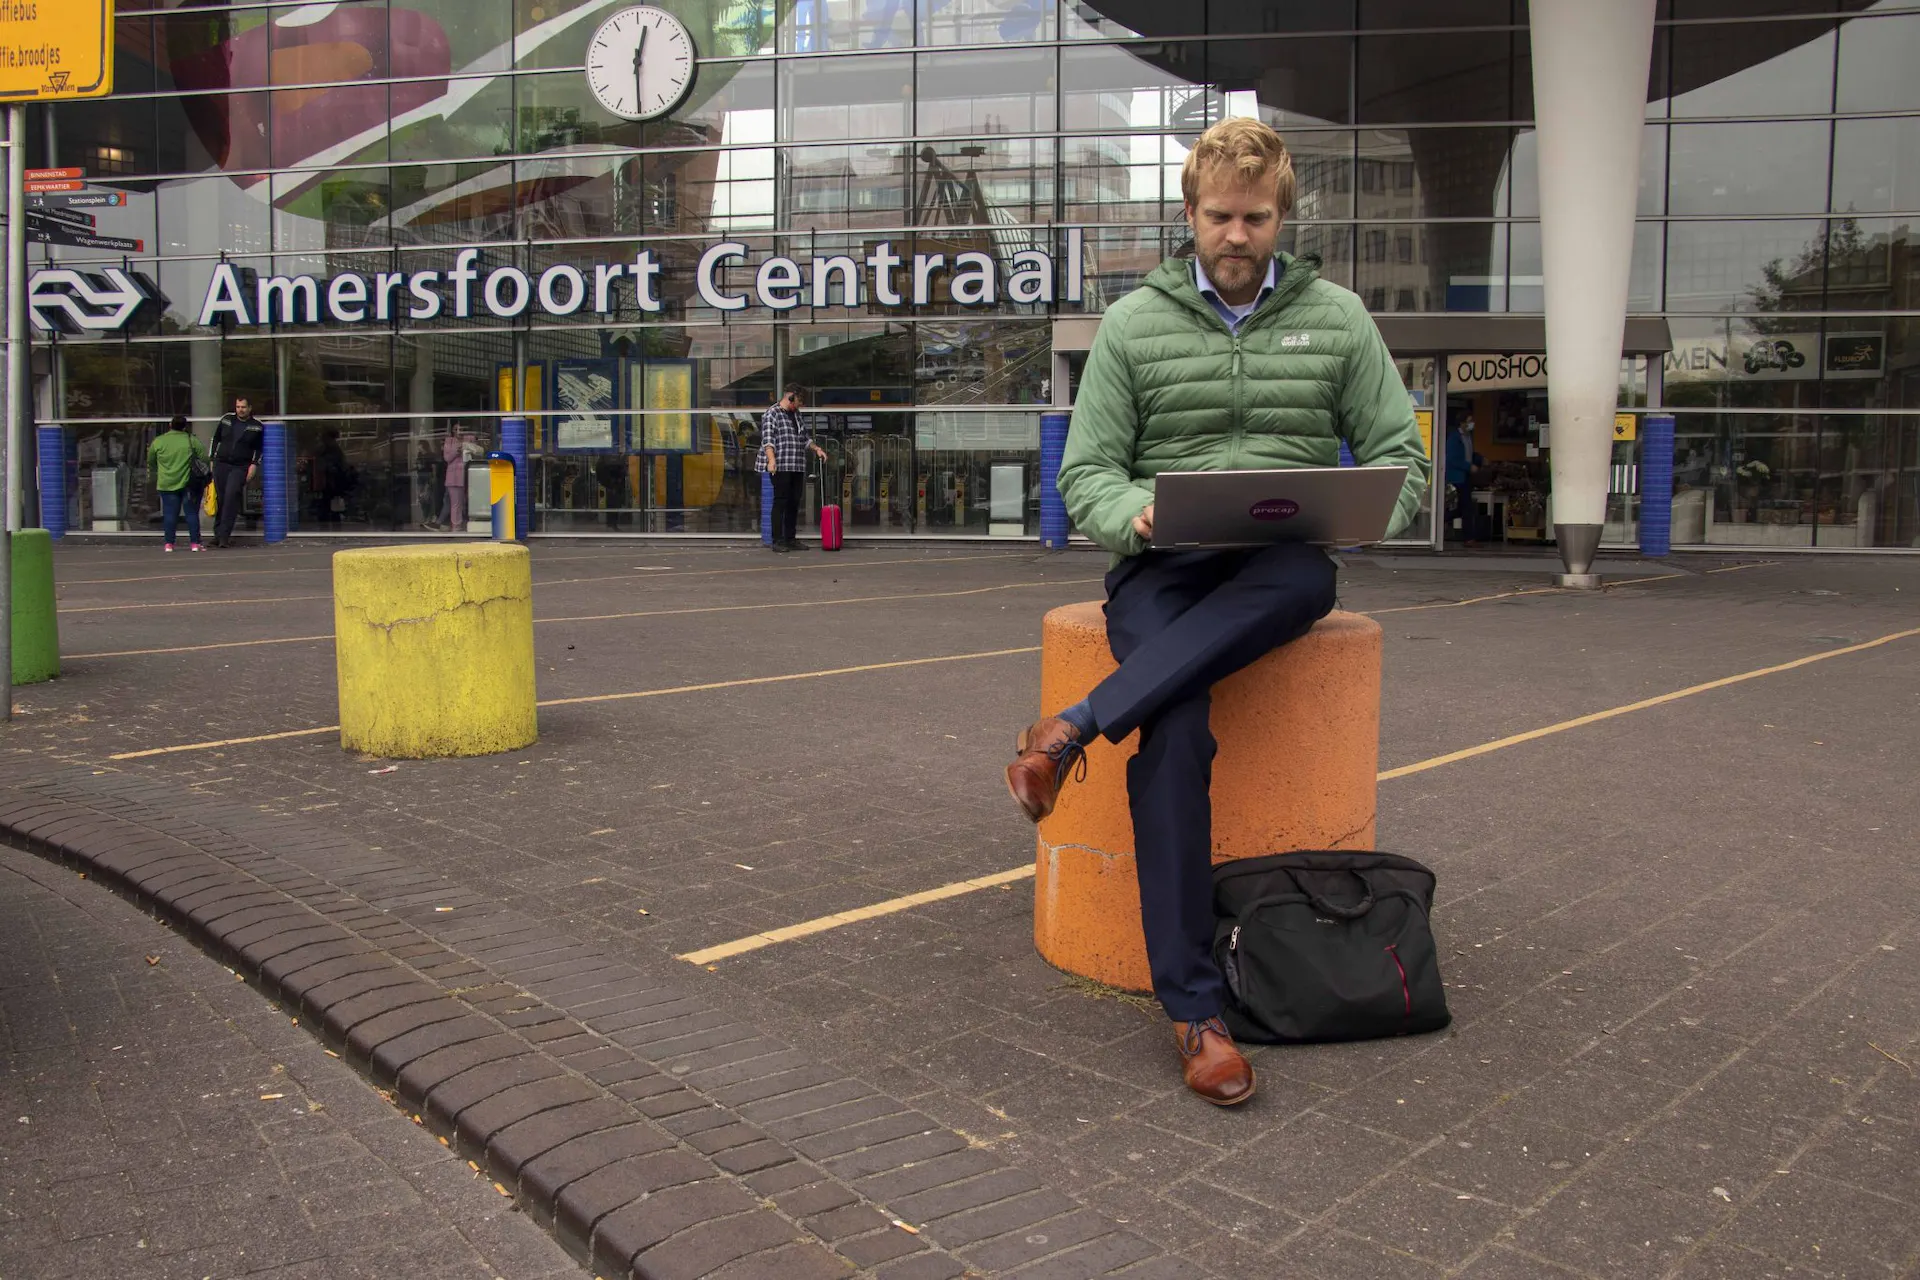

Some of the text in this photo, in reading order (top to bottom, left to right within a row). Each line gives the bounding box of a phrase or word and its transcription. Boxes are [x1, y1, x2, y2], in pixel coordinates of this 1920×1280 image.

[68, 196, 106, 205] Stationsplein
[198, 226, 1085, 327] Amersfoort Centraal
[1457, 355, 1548, 383] OUDSHO
